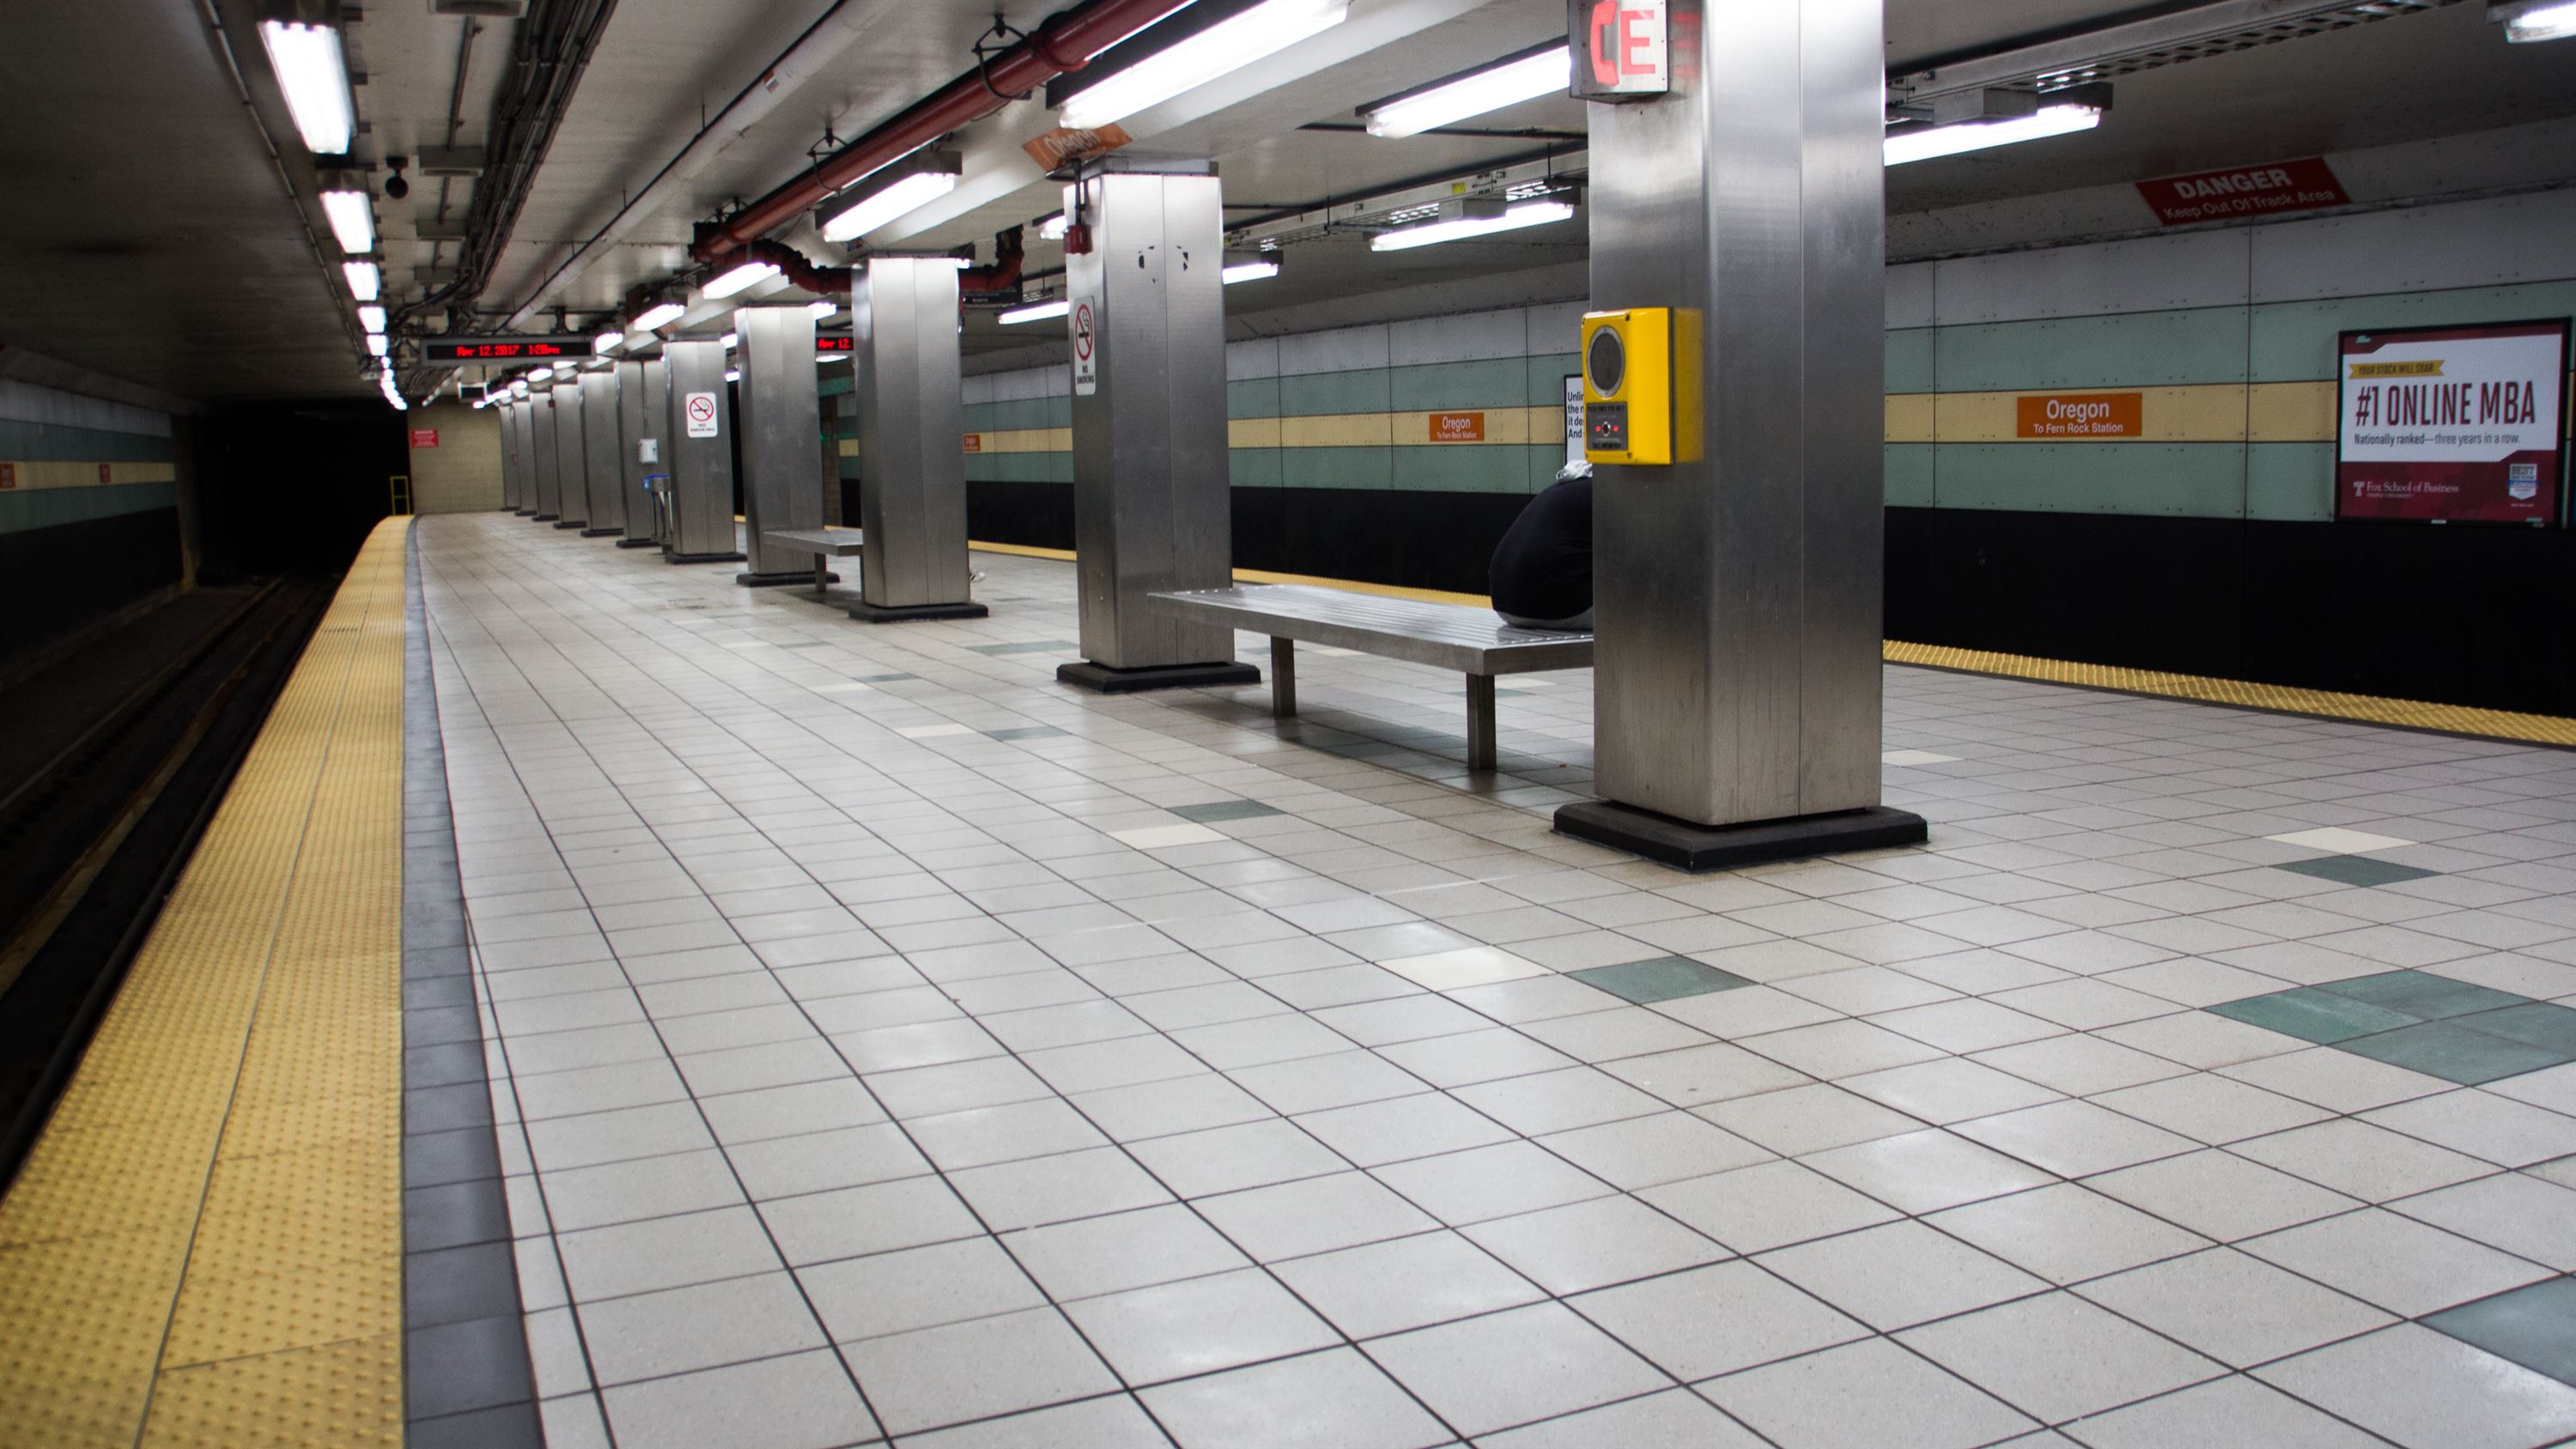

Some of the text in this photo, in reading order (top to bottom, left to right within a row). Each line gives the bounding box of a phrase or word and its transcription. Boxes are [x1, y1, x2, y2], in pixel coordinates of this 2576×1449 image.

[1619, 9, 1656, 75] E
[1044, 130, 1101, 157] Oregon
[2173, 168, 2293, 199] DANGER
[2164, 190, 2336, 220] Keep Out Of Track Area
[495, 344, 519, 356] 2017
[1082, 365, 1088, 373] NO
[2358, 362, 2434, 374] YOUR STOCK WILL SOAR
[1077, 375, 1094, 385] SMOKING
[1568, 404, 1579, 414] the
[2356, 380, 2536, 427] #1 ONLINE MBA
[2046, 399, 2110, 423] Oregon
[1442, 415, 1470, 432] Oregon
[1569, 416, 1573, 426] it
[1568, 428, 1583, 439] And
[2033, 422, 2123, 433] To Fern Rock Station
[2354, 433, 2395, 446] Nationally
[2458, 434, 2482, 446] years
[2484, 432, 2492, 444] in
[2494, 434, 2500, 444] a
[2501, 433, 2520, 444] row.
[2512, 466, 2535, 475] BEST
[2366, 481, 2459, 493] Fox School of Business
